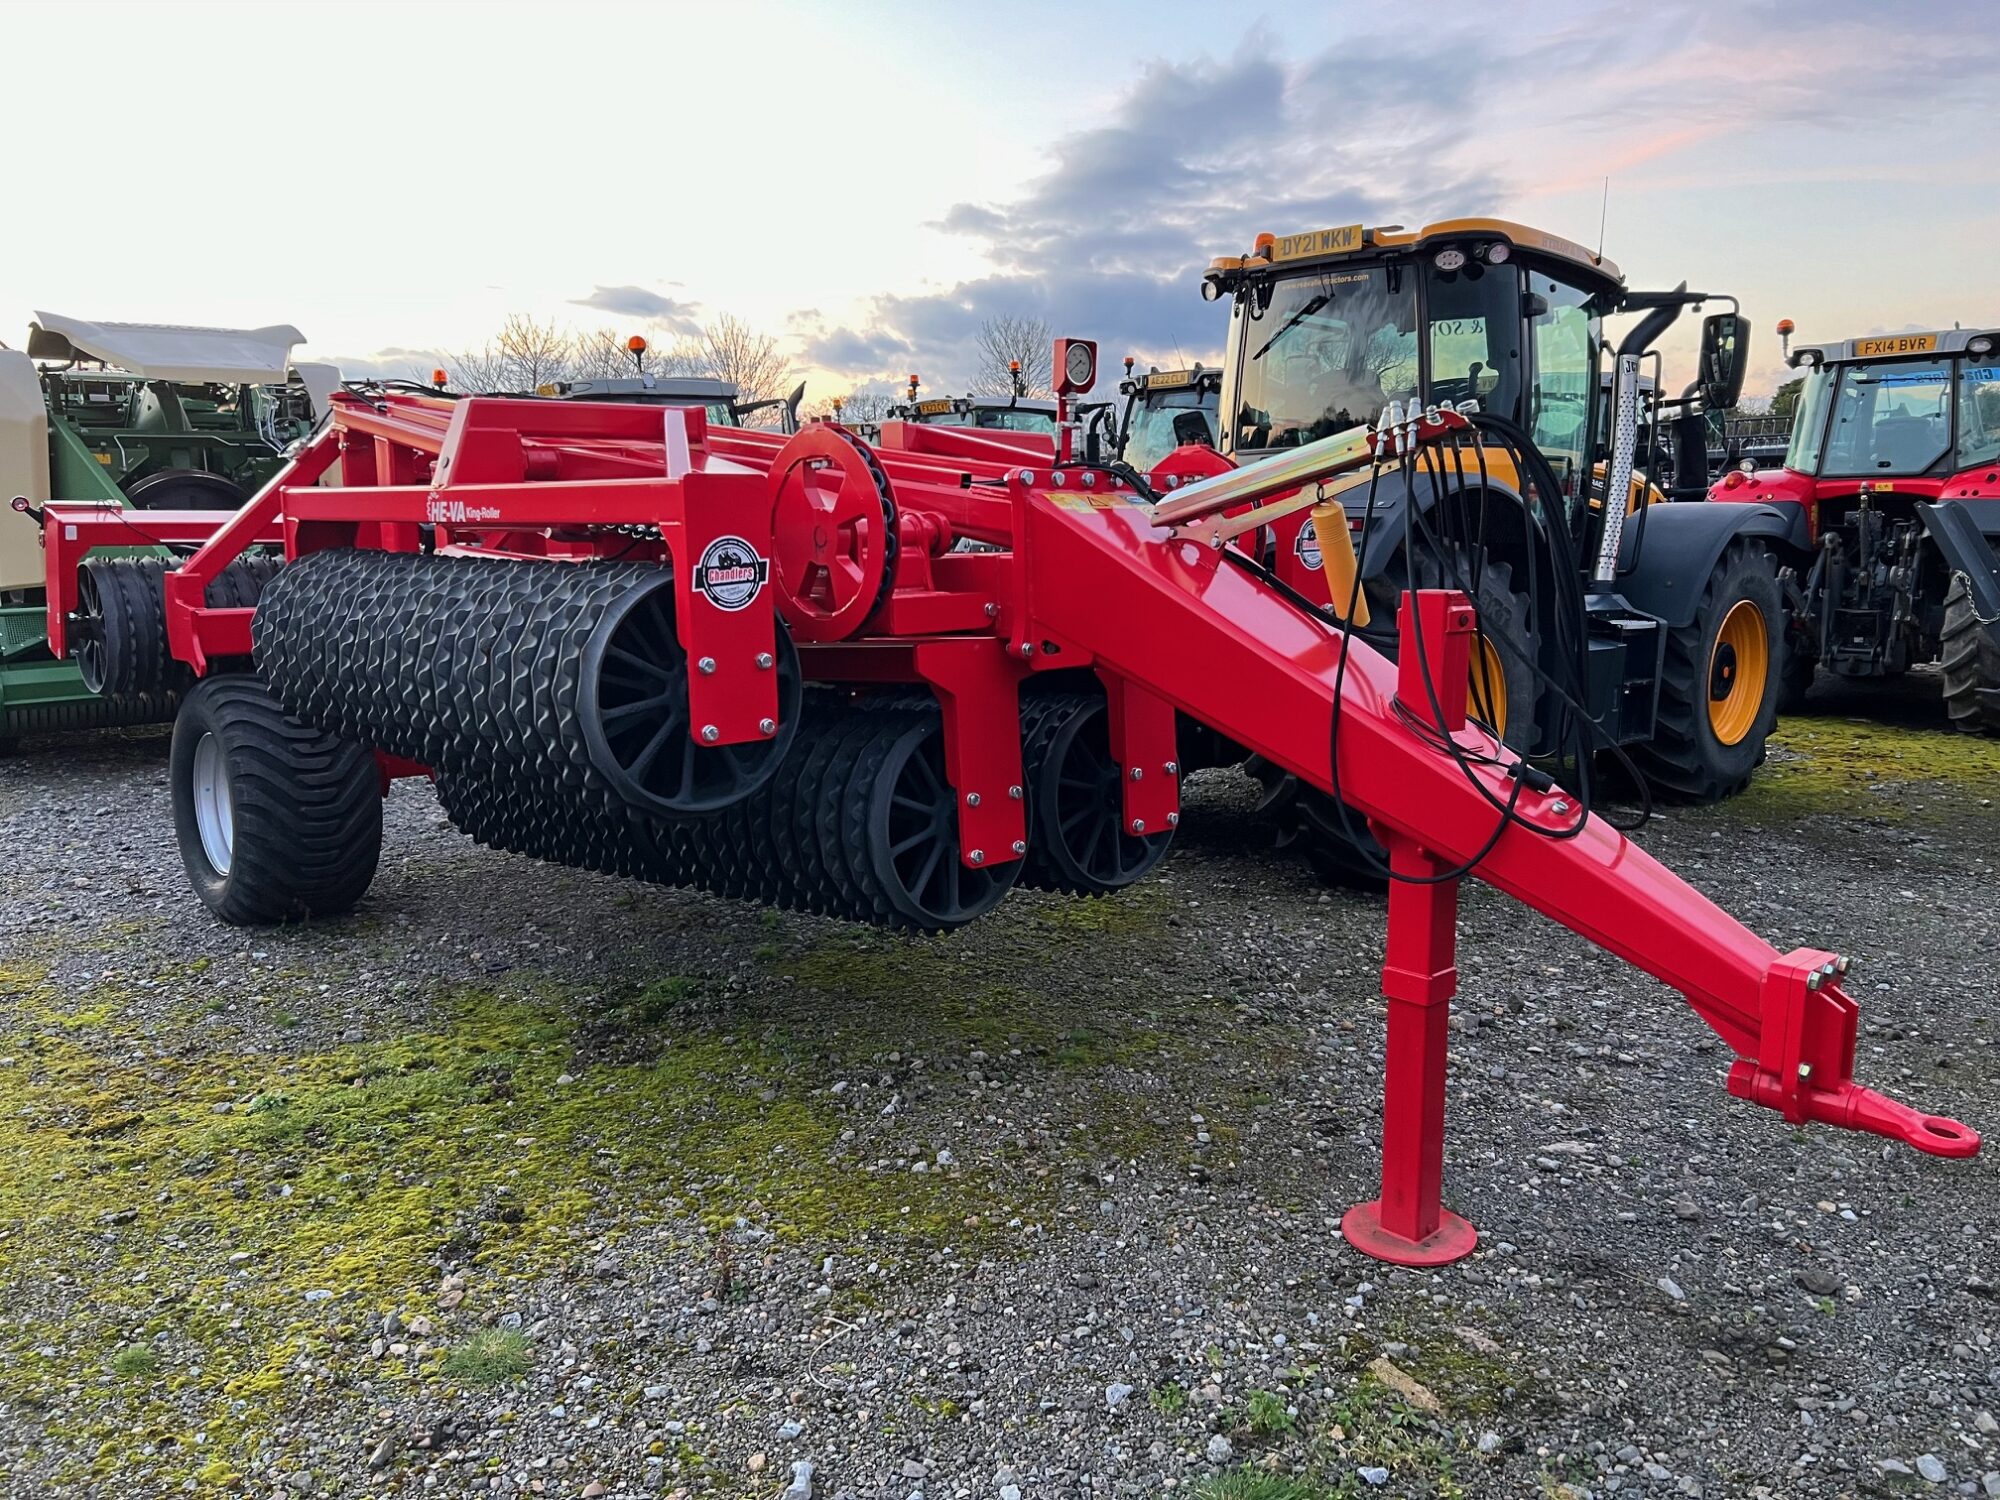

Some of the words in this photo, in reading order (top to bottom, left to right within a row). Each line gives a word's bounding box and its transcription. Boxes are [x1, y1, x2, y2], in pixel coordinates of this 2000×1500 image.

[1282, 233, 1316, 256] DY21
[1321, 228, 1352, 249] WKW
[1865, 341, 1895, 354] FX14
[1899, 338, 1927, 351] BVR
[431, 501, 466, 522] HE-VA
[466, 506, 500, 521] King-Roller
[708, 567, 754, 583] Chandlers
